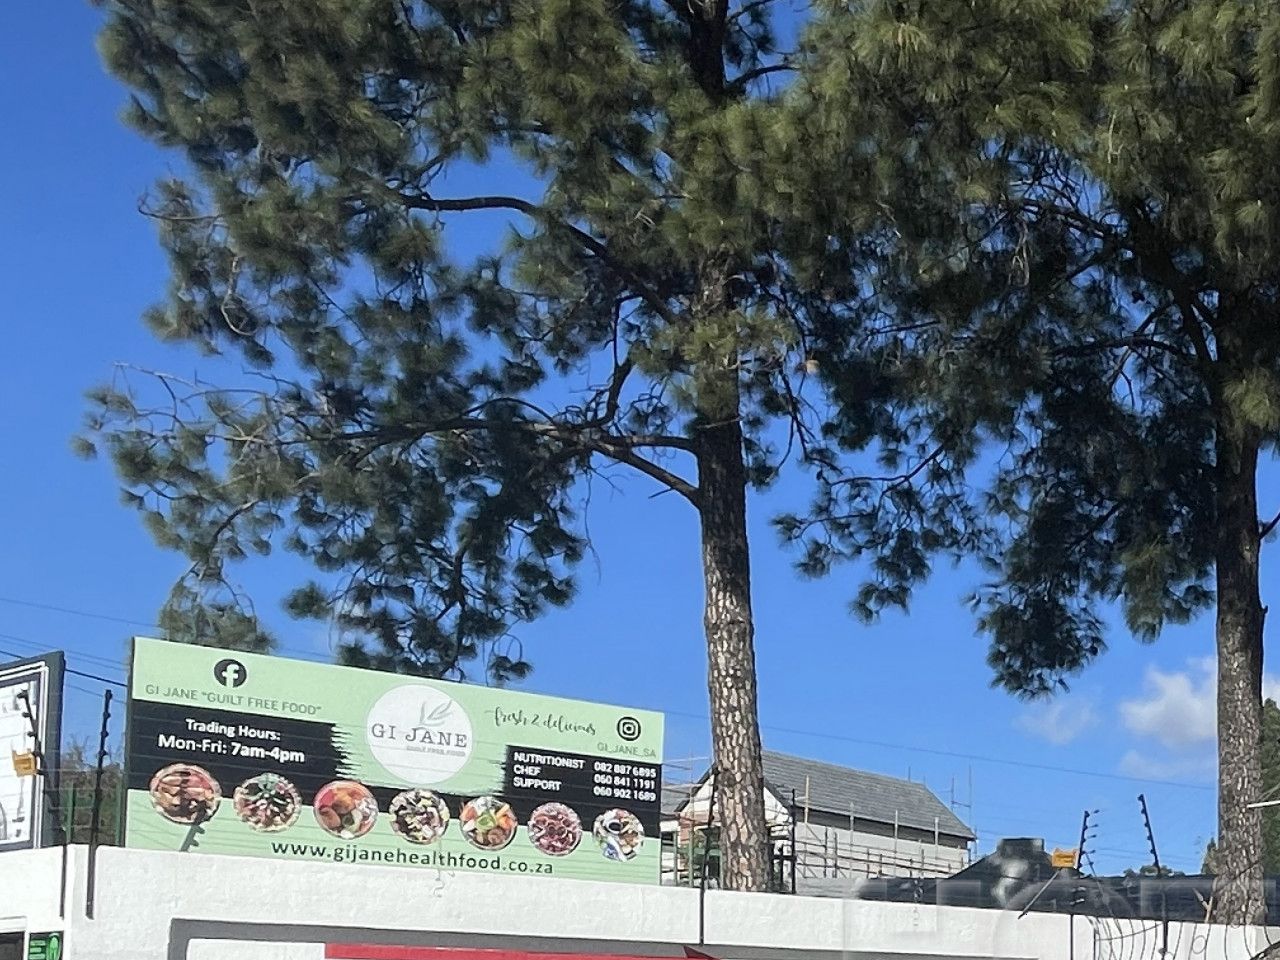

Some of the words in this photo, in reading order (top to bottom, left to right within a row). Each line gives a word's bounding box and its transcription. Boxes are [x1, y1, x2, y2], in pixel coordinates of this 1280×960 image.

[146, 684, 159, 696] GI
[163, 687, 197, 700] JANE
[201, 692, 243, 707] "GUILT
[247, 697, 279, 711] FREE
[282, 701, 322, 716] FOOD"
[185, 718, 236, 738] Trading
[239, 725, 281, 741] Hours:
[494, 706, 528, 728] fresh
[371, 723, 396, 740] GI
[405, 728, 468, 748] JANE
[158, 734, 228, 755] Mon-Fri:
[231, 742, 306, 764] 7am-4pm
[513, 751, 586, 770] NUTRITIONIST
[594, 760, 613, 774] 082
[513, 764, 541, 777] CHEF
[594, 773, 613, 785] 060
[613, 776, 631, 787] 841
[633, 778, 655, 790] 1191
[513, 776, 562, 791] SUPPORT
[593, 785, 613, 798] 060
[613, 788, 632, 799] 902
[271, 840, 554, 875] www.gijanehealthfood.co.za
